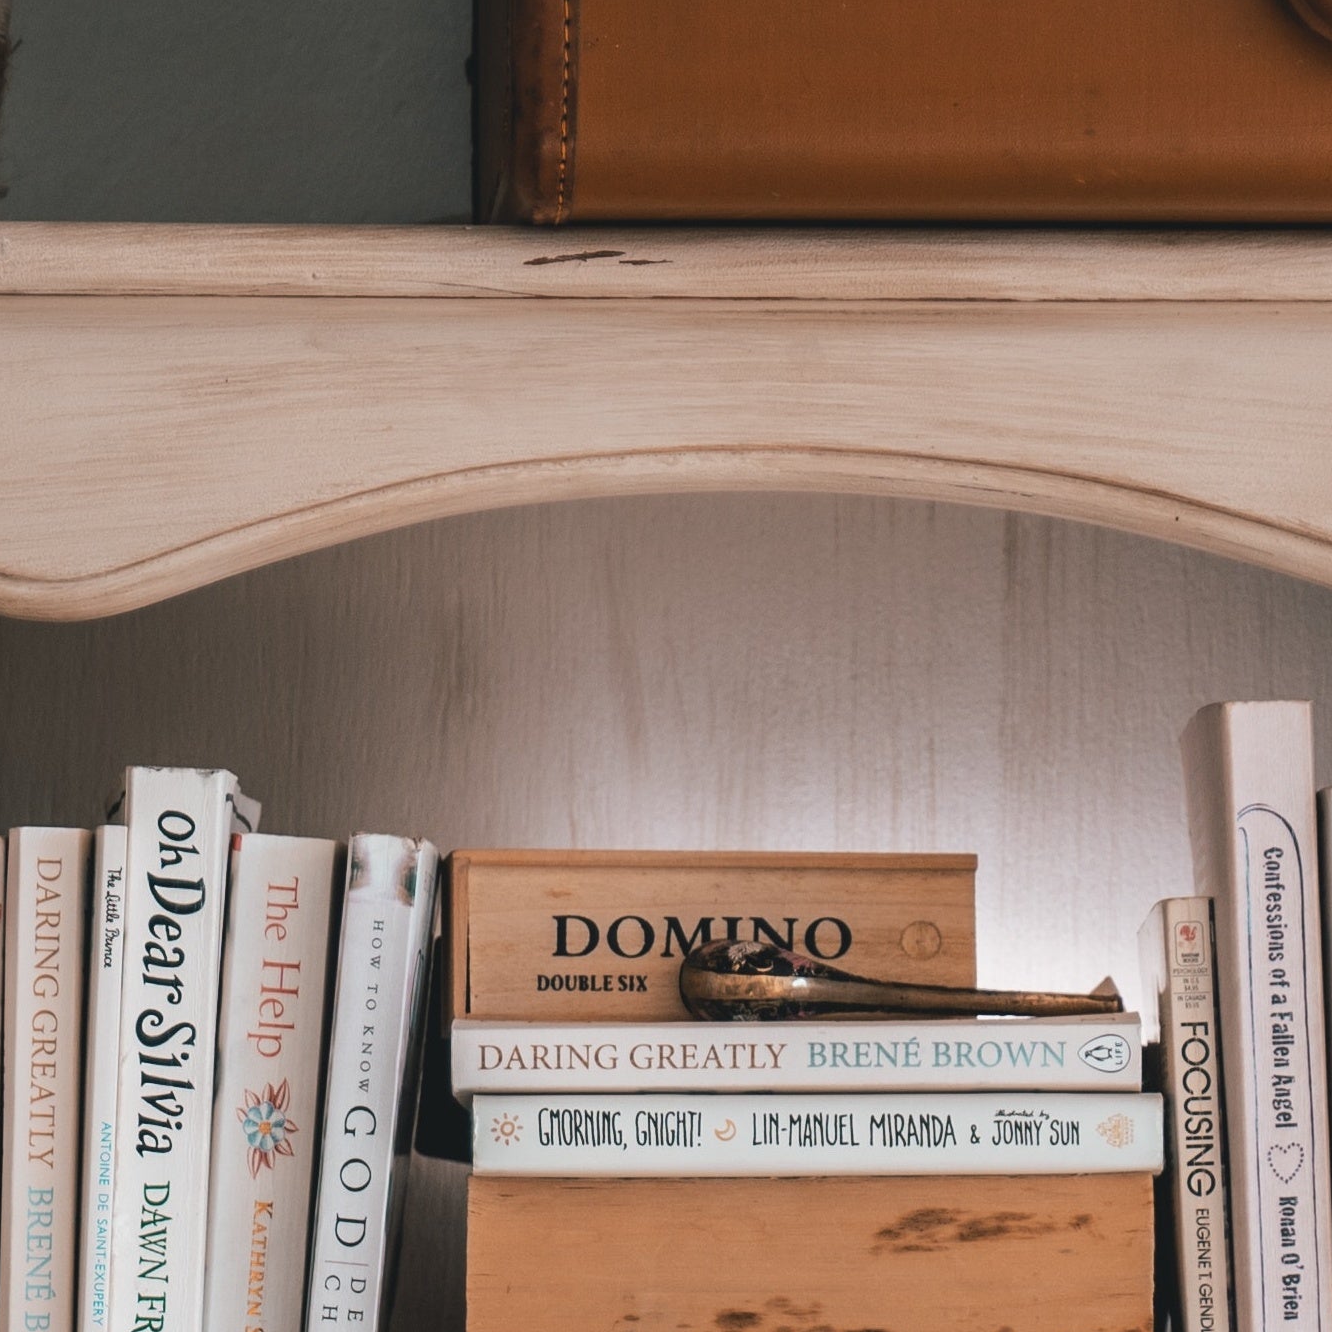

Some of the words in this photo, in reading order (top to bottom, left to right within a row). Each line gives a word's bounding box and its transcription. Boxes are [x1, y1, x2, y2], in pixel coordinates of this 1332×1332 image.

[264, 876, 299, 942] The
[1263, 847, 1291, 962] Confessions
[146, 873, 206, 1004] Dear
[369, 920, 384, 969] HOW
[552, 915, 852, 960] DOMINO
[365, 984, 378, 1011] TO
[536, 974, 612, 992] DOUBLE
[618, 975, 647, 993] SIX
[1268, 968, 1290, 987] of
[1271, 993, 1289, 1004] a
[254, 958, 299, 1058] Help
[357, 1025, 374, 1093] KNOW
[477, 1043, 621, 1071] DARING
[628, 1043, 788, 1071] GREATLY
[807, 1036, 922, 1070] BRENÉ
[931, 1040, 1066, 1067] BROWN
[1270, 1012, 1295, 1068] Fallen
[135, 1010, 196, 1157] Silvia
[1179, 1021, 1215, 1197] FOCUSING
[1271, 1074, 1298, 1129] Angel
[537, 1108, 628, 1148] GMORNING,
[635, 1109, 703, 1146] GNIGHT!
[752, 1113, 859, 1147] LIN-MANUEL
[869, 1113, 957, 1147] MIRANDA
[970, 1126, 980, 1144] &
[992, 1119, 1043, 1147] JONNY
[1049, 1119, 1081, 1145] SUN
[333, 1105, 377, 1248] GOD
[137, 1182, 172, 1283] DAWN
[1279, 1195, 1298, 1248] Ronan
